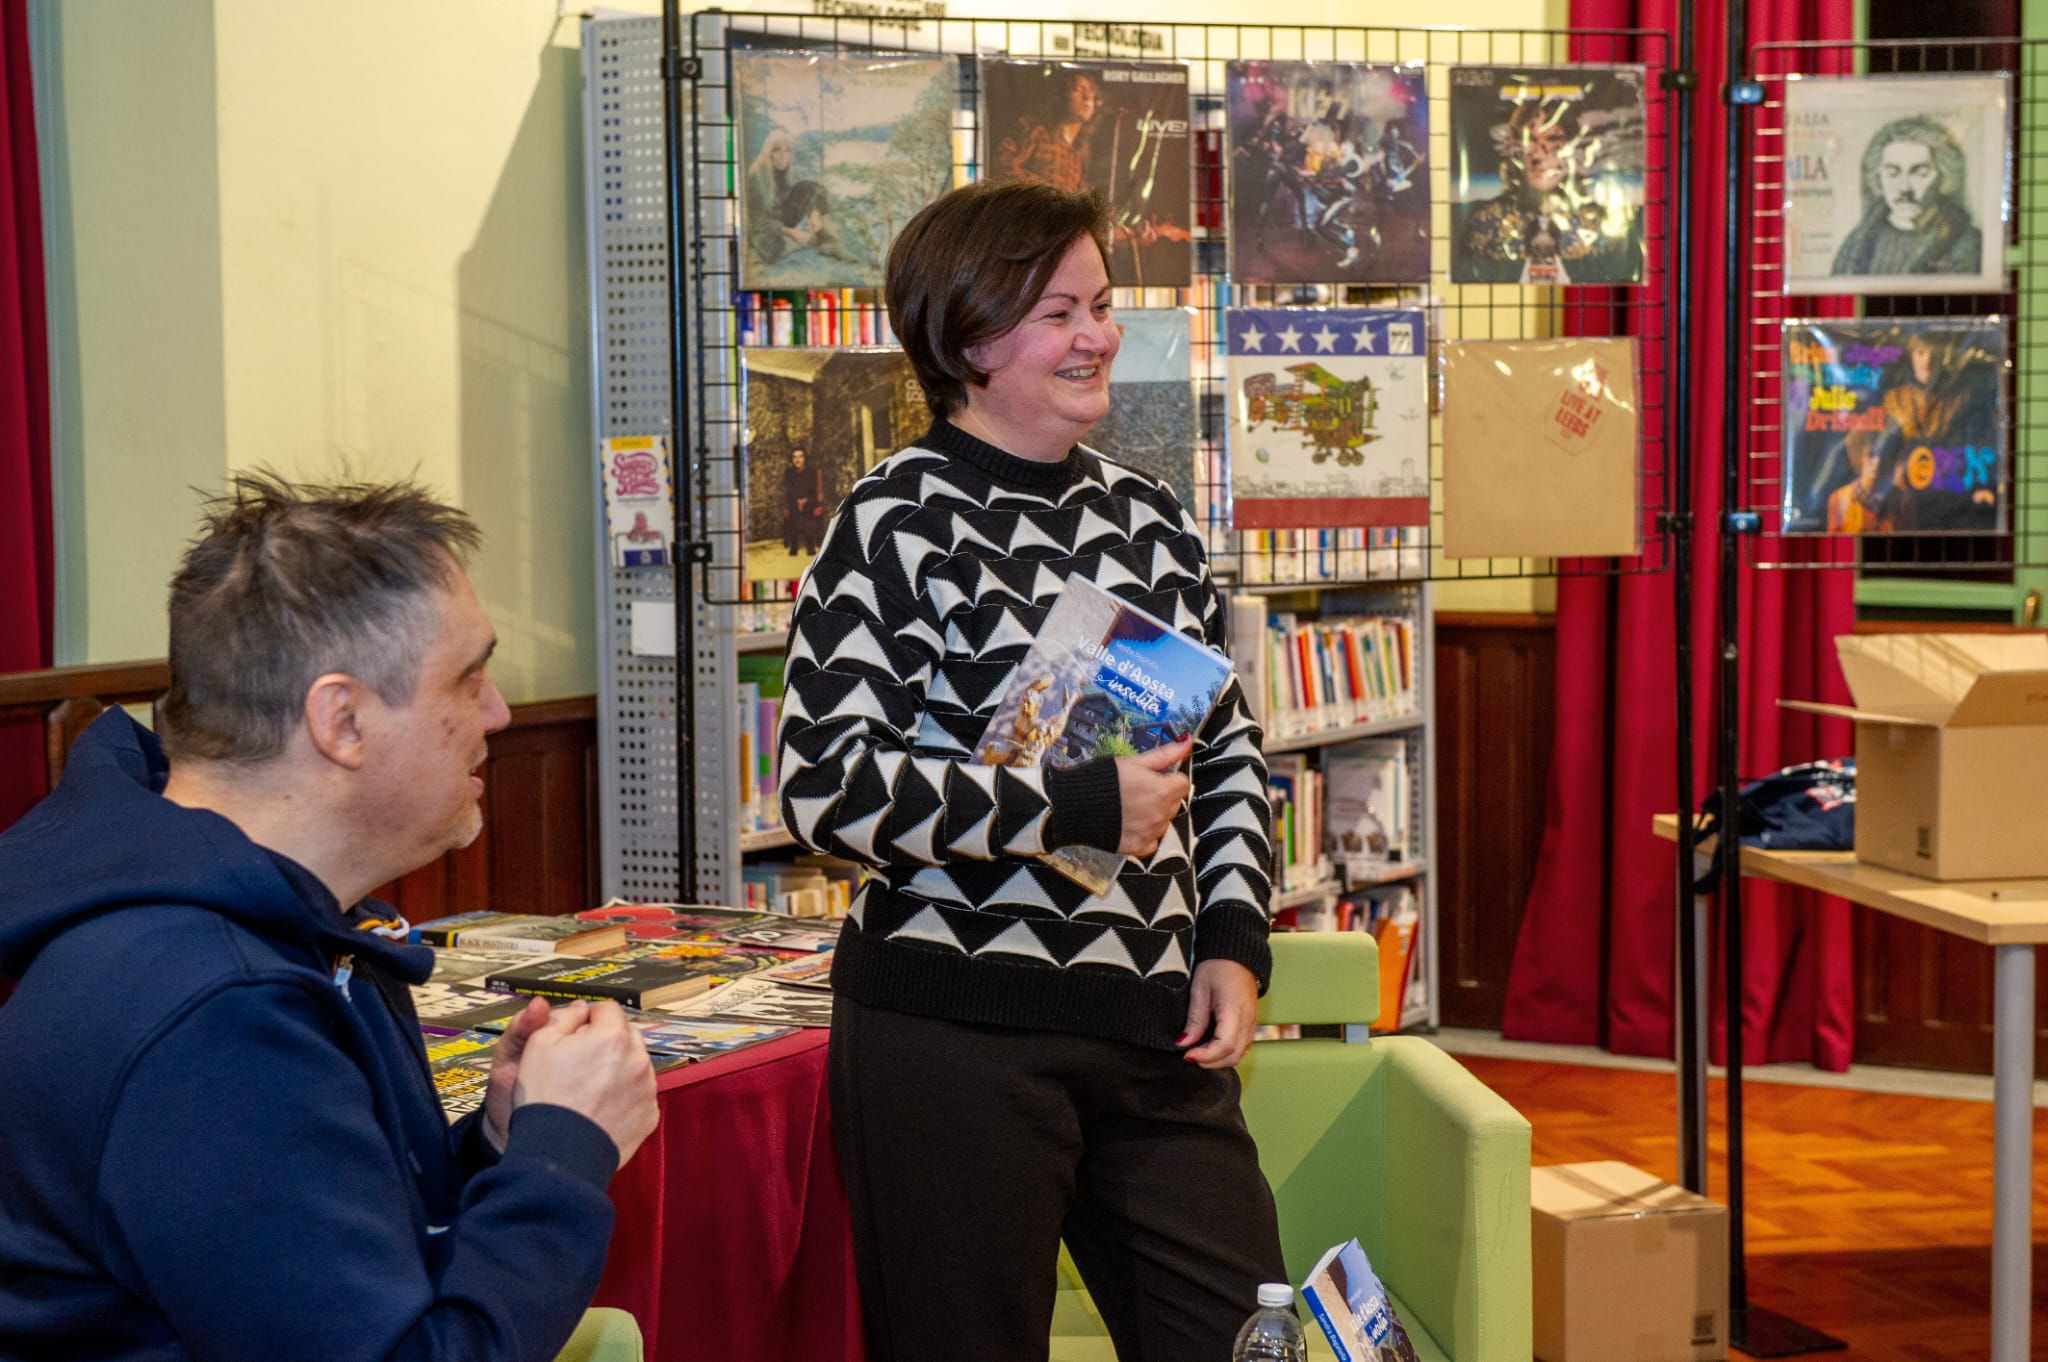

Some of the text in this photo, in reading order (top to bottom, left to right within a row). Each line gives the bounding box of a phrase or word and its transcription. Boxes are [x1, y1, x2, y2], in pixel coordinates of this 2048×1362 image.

[1103, 69, 1186, 85] RORY GALLAGHER
[1078, 635, 1117, 667] Valle
[1117, 659, 1176, 703] d'Aosta
[1107, 675, 1163, 715] insolita
[458, 937, 519, 950] BLACK PANTHERS
